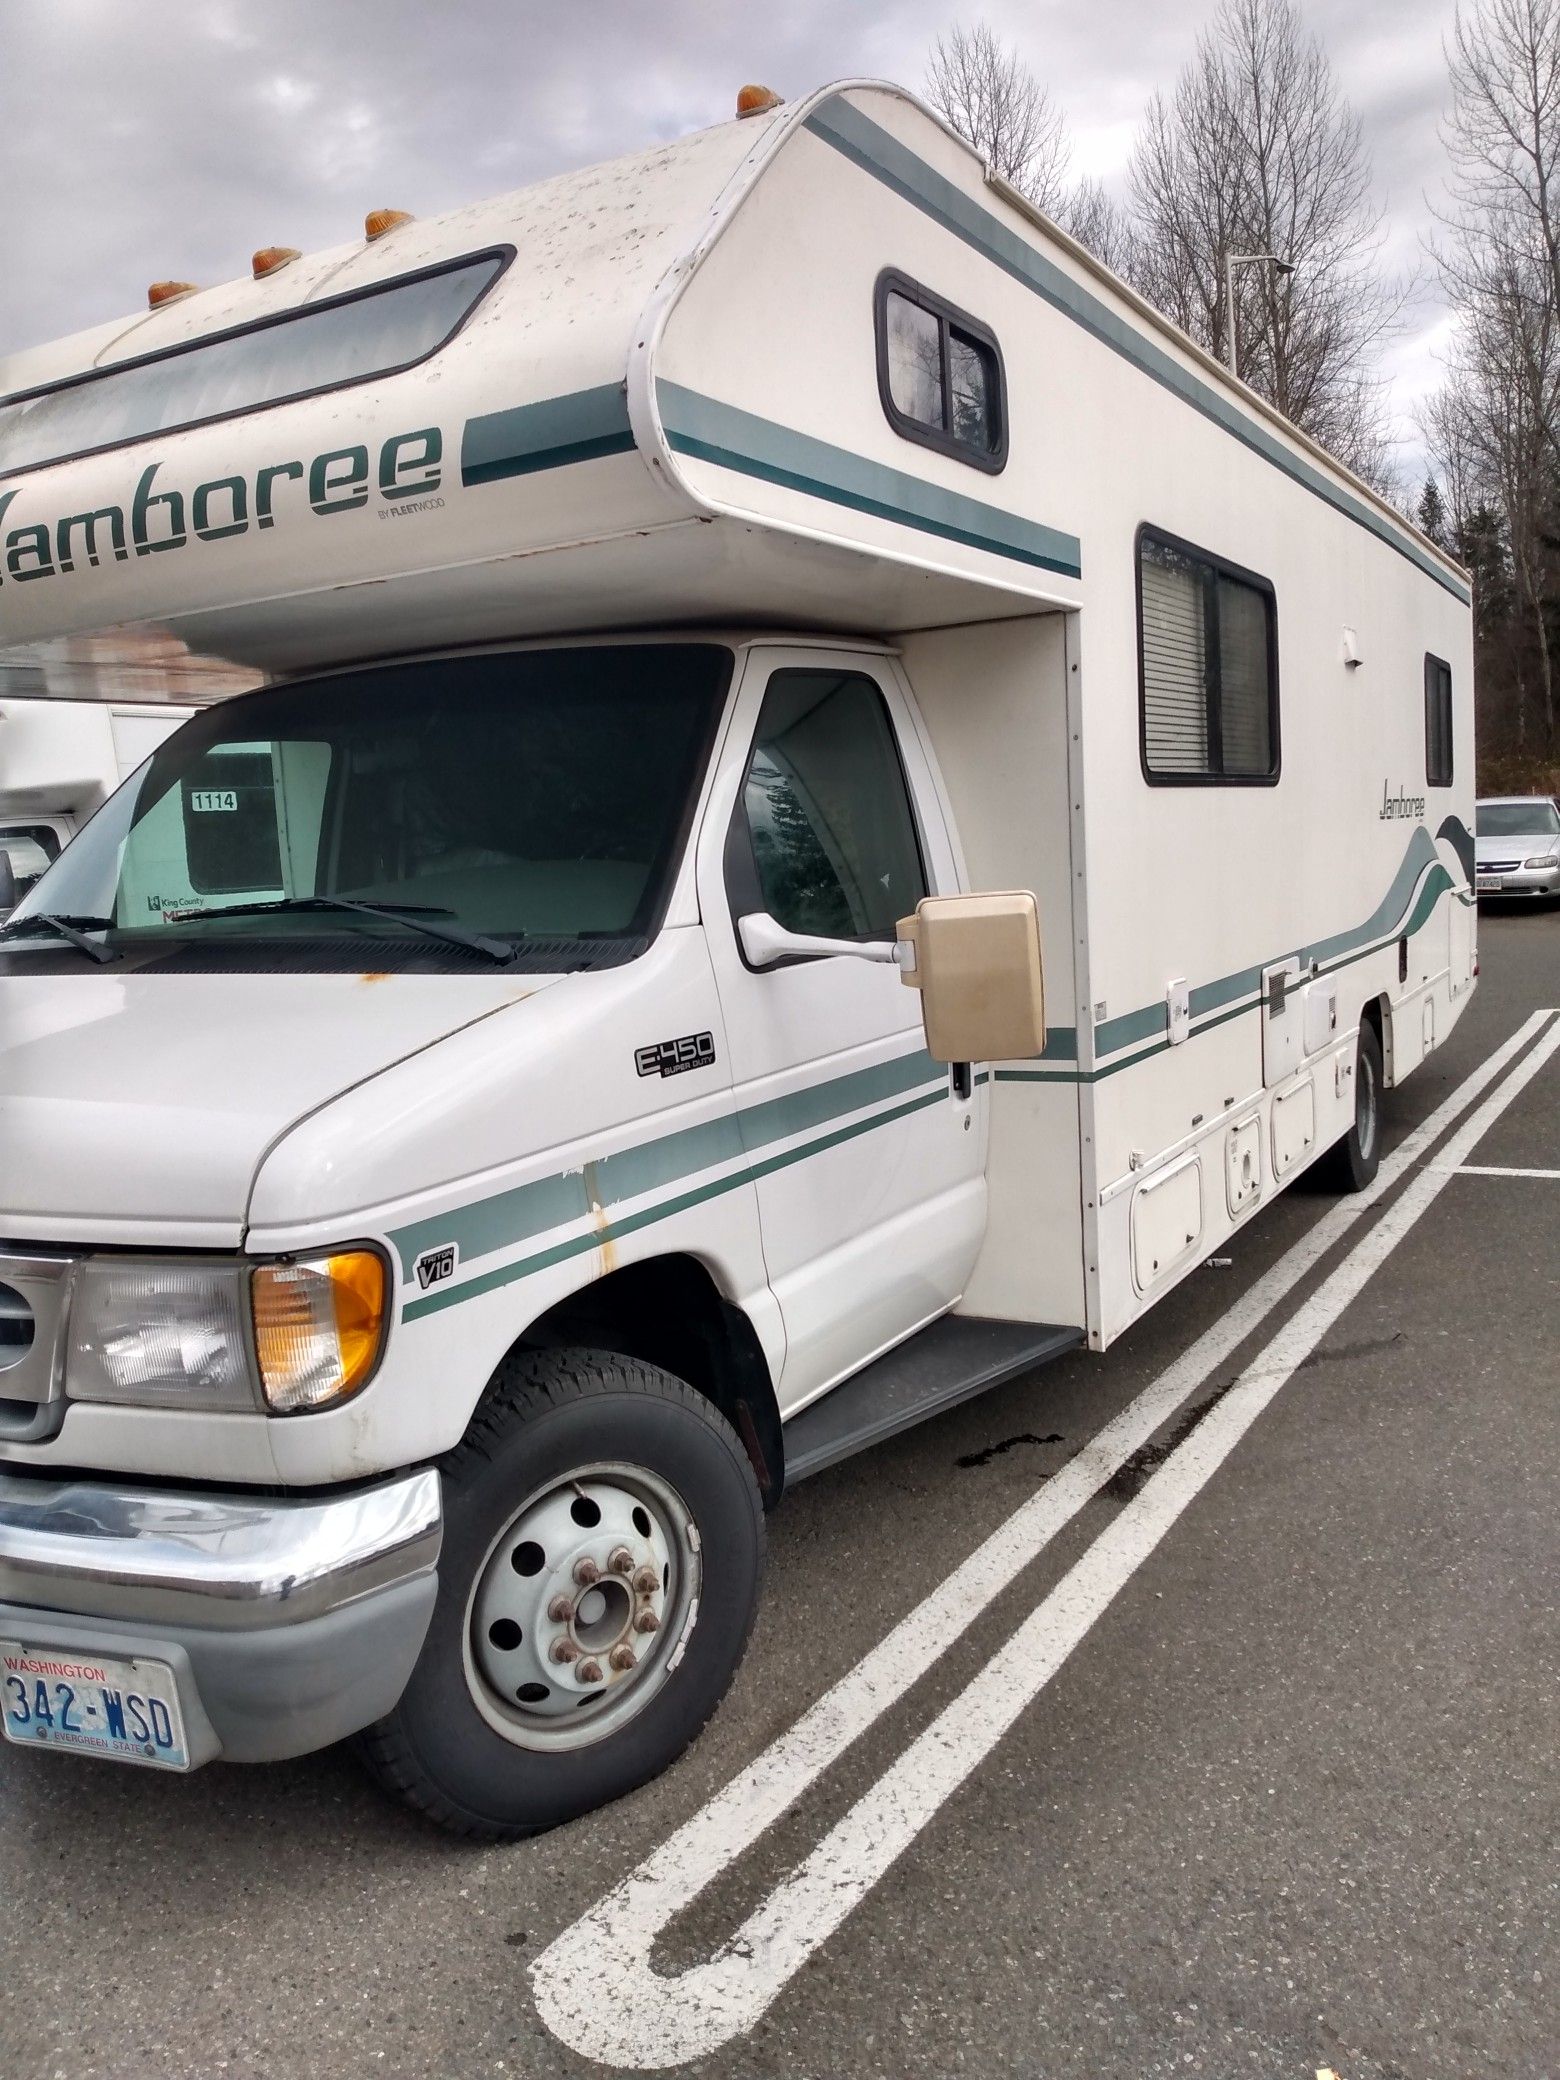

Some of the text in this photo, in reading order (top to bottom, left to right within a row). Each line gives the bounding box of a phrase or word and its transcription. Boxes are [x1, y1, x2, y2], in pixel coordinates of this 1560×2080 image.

[378, 497, 445, 519] BY FLEETWOOD
[194, 793, 234, 809] 1114
[161, 897, 204, 908] King County
[663, 1055, 713, 1075] SUPER DUTY
[422, 1249, 453, 1265] TRITON
[419, 1258, 452, 1288] V10
[3, 1656, 106, 1682] WASHINGTON
[6, 1674, 173, 1748] 342-WSD
[54, 1731, 142, 1754] EVERGREEN STATE
